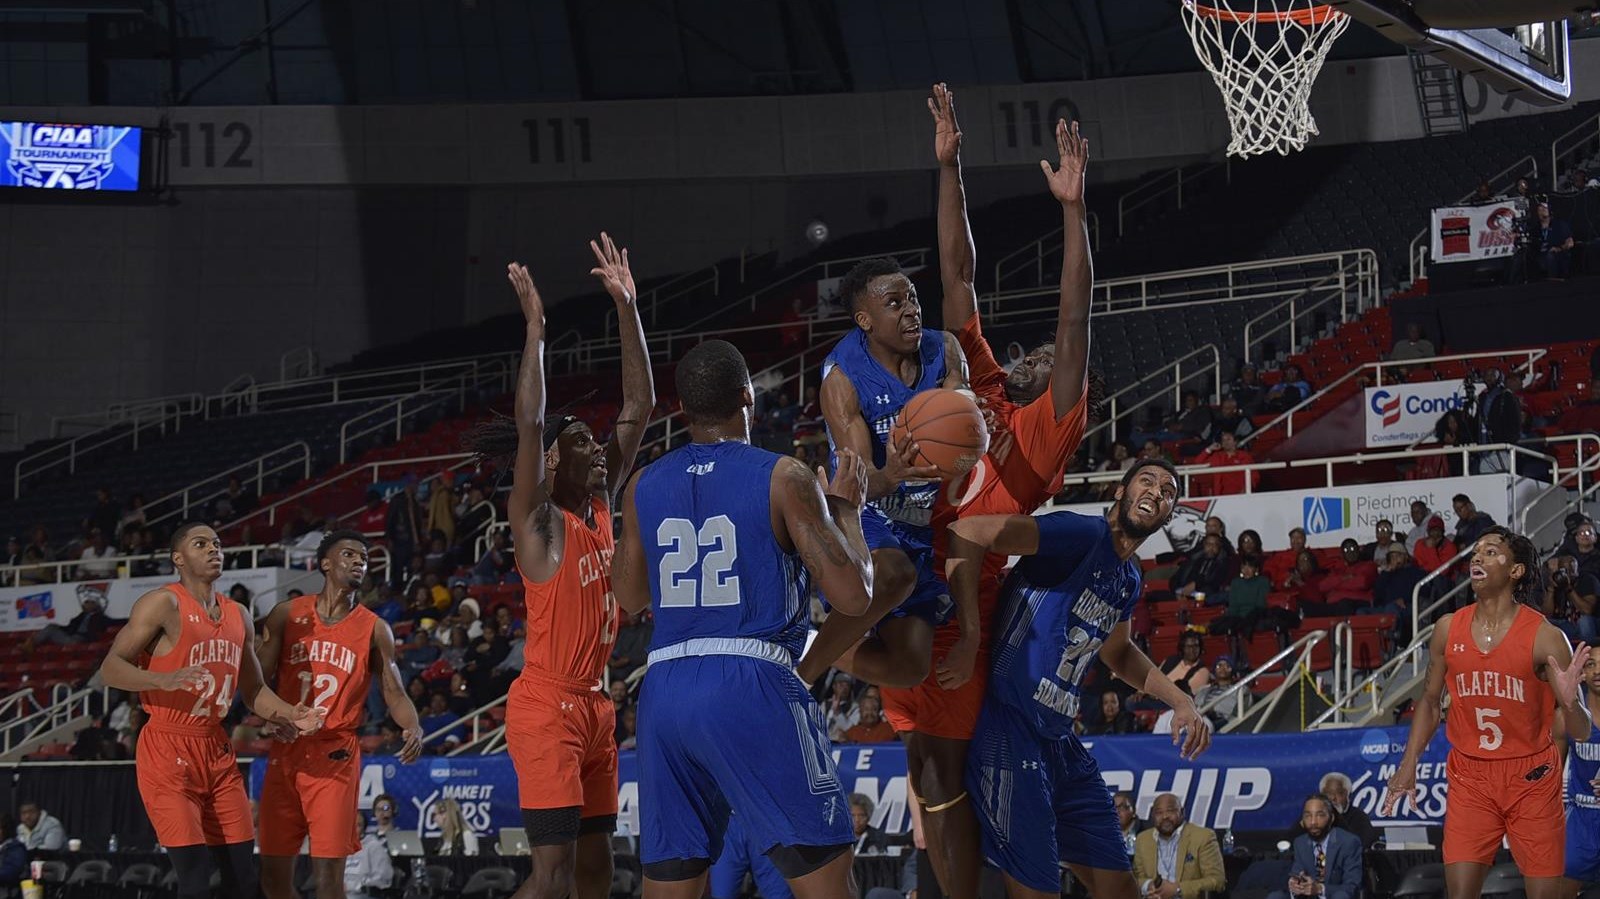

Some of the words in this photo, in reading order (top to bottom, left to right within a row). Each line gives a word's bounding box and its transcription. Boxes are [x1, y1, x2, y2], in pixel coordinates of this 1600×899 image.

[33, 126, 92, 143] CIAA
[172, 121, 253, 168] 112
[522, 118, 592, 163] 111
[15, 148, 108, 160] TOURNAMENT
[1357, 492, 1435, 511] Piedmont
[1357, 512, 1412, 528] Natura
[657, 514, 741, 608] 22
[190, 639, 242, 671] CLAFLIN
[290, 640, 356, 675] CLAFLIN
[190, 673, 233, 718] 24
[297, 671, 338, 716] 12
[1456, 671, 1525, 703] CLAFLIN
[1475, 707, 1503, 751] 5
[1361, 743, 1390, 754] NCAA
[430, 768, 450, 778] NCAA
[452, 768, 473, 777] Division
[442, 785, 478, 799] MAKE
[479, 785, 495, 799] IT
[411, 789, 491, 838] YORS
